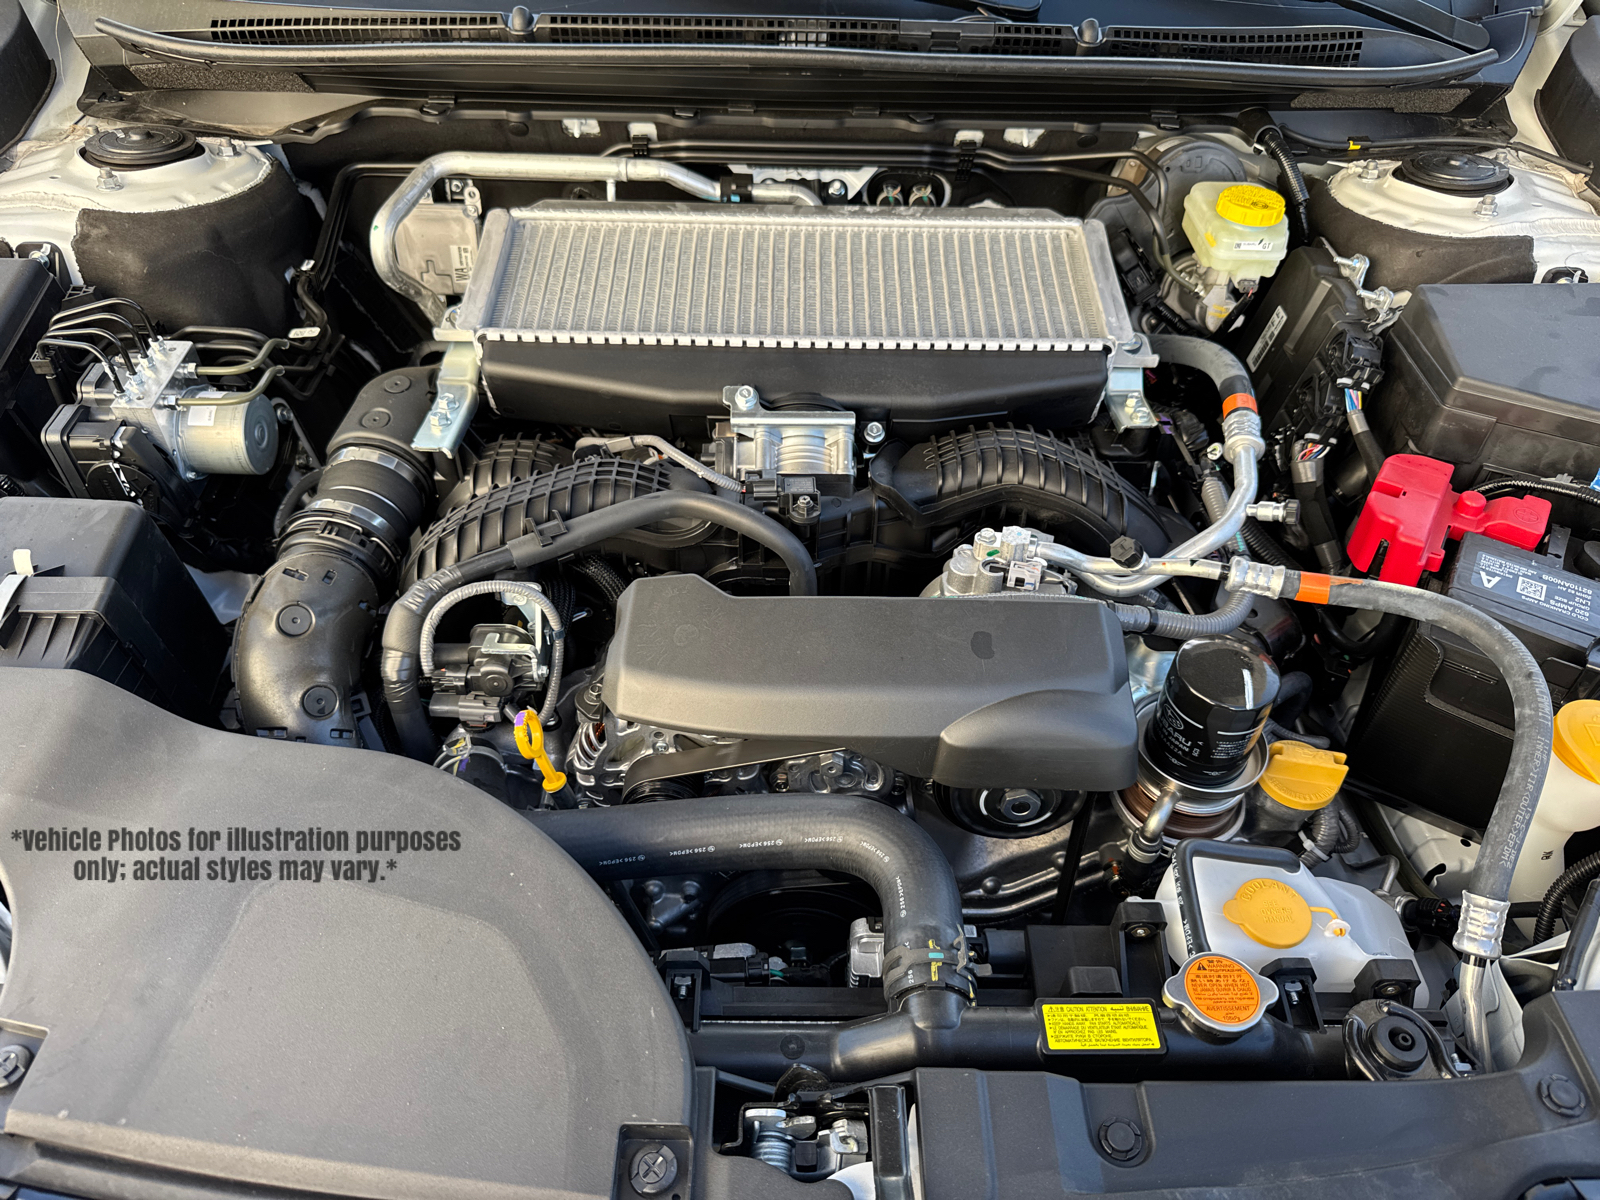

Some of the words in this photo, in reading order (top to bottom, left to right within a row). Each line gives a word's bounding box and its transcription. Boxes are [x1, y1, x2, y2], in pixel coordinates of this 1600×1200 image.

[1521, 596, 1538, 604] AMPS
[1574, 597, 1591, 606] LN2
[1539, 600, 1570, 616] CRANKING
[1550, 600, 1574, 611] AMPS
[1568, 601, 1590, 610] GROUP
[1572, 613, 1589, 622] COLD
[1241, 880, 1299, 902] COOLANT
[1262, 900, 1278, 908] SEE
[1263, 915, 1294, 924] MANUAL
